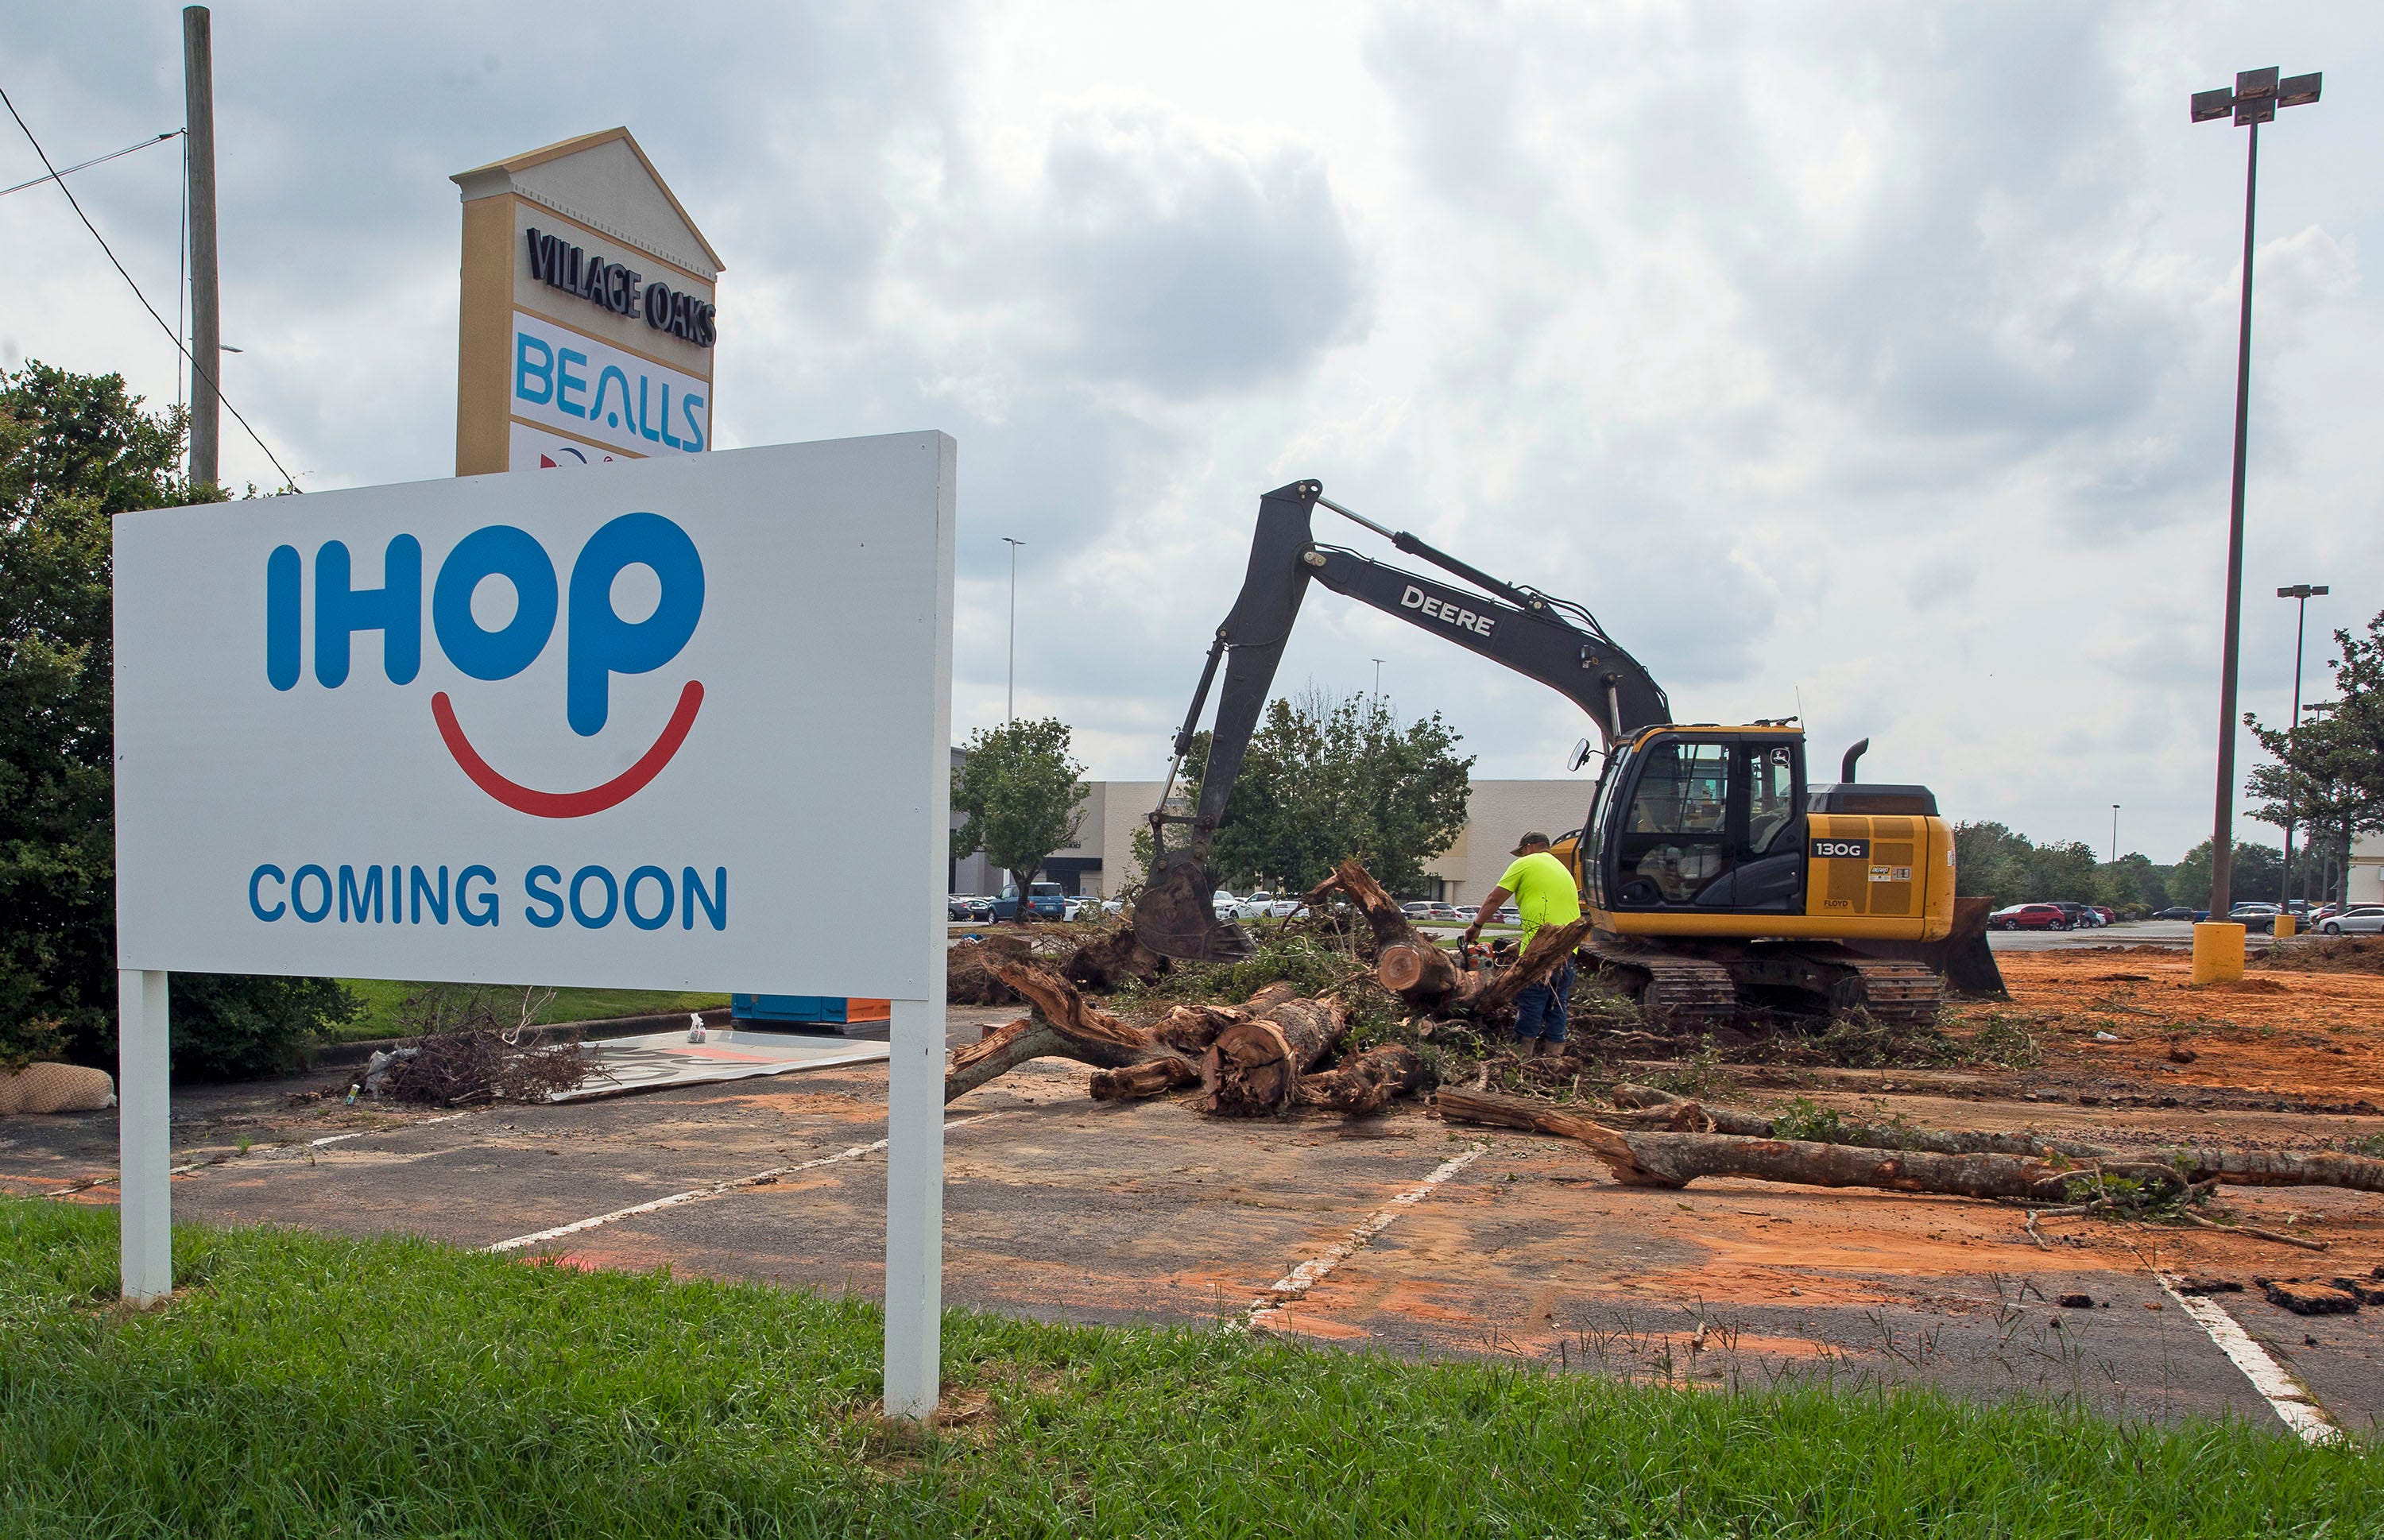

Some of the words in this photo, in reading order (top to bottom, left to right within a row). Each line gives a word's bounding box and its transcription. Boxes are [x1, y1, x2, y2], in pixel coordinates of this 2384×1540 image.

[526, 227, 641, 319] VILLAGE
[645, 281, 717, 348] OAKS
[516, 331, 705, 453] BEALLS
[1400, 585, 1496, 637] DEERE
[1816, 842, 1861, 857] 130G
[249, 864, 500, 928] COMING
[524, 865, 727, 931] SOON
